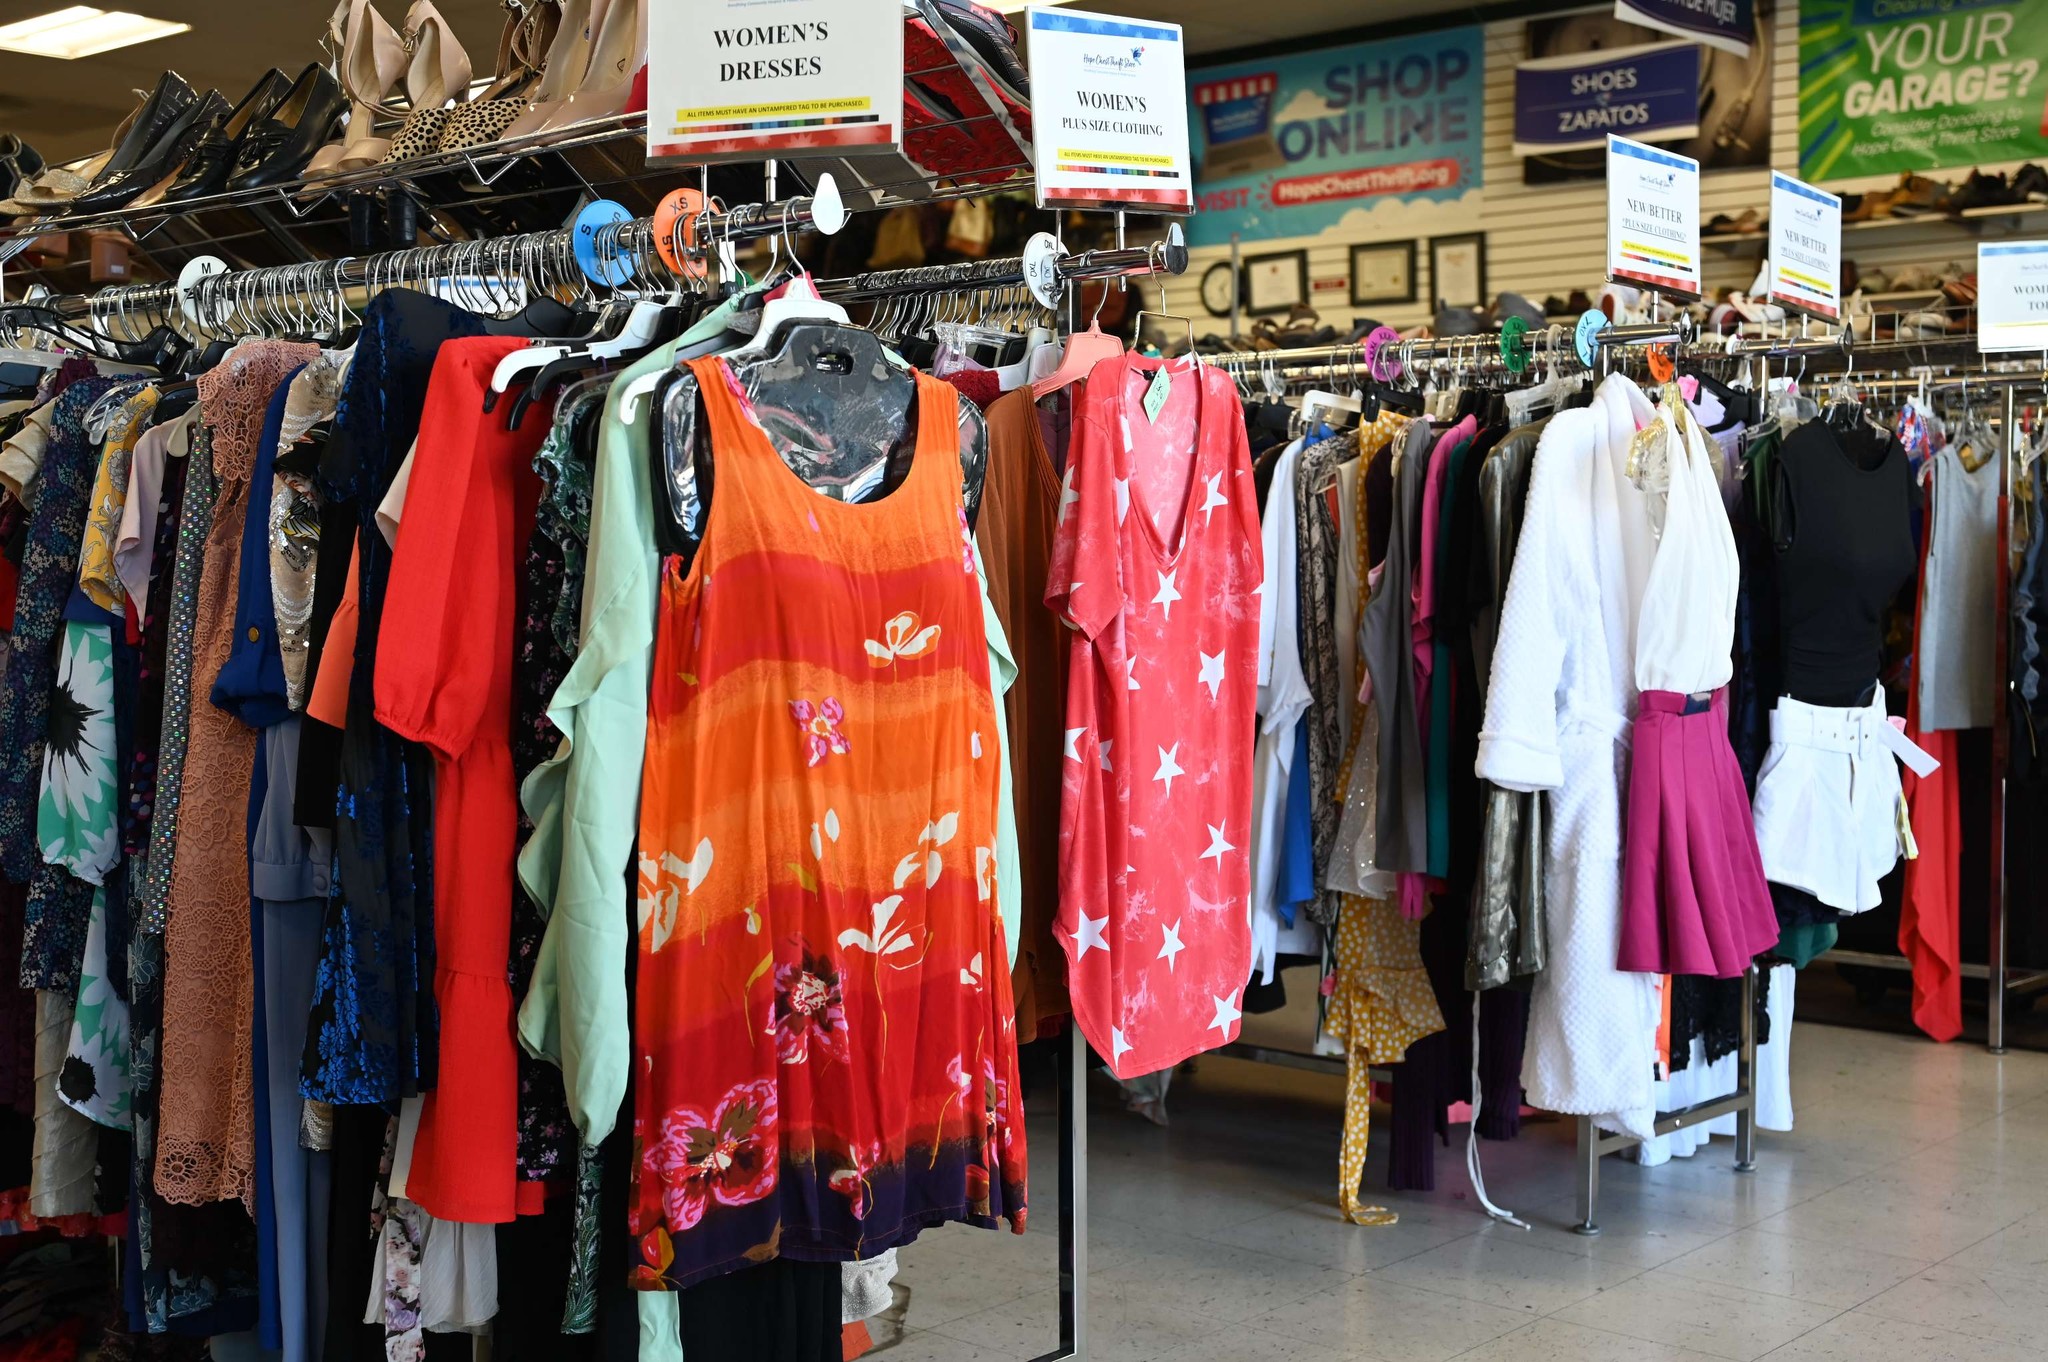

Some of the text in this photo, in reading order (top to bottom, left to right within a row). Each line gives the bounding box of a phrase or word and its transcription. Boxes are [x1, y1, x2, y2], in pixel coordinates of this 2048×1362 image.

[713, 21, 829, 49] WOMEN'S
[1866, 11, 2014, 75] YOUR
[719, 56, 822, 82] DRESSES
[1325, 48, 1471, 110] SHOP
[1571, 67, 1637, 96] SHOES
[1843, 58, 2039, 118] GARAGE?
[758, 104, 797, 113] UNTAMPERED
[1076, 90, 1147, 113] WOMEN'S
[1062, 117, 1163, 136] PLUS SIZE CLOTHING
[1278, 97, 1469, 162] ONLINE
[1558, 103, 1649, 133] ZAPATOS
[1980, 125, 2020, 143] Store
[1195, 166, 1450, 213] VISIT HopeChestThrift.org
[670, 197, 688, 215] XS
[581, 223, 592, 236] S
[201, 262, 212, 274] M
[2013, 285, 2048, 295] WOM
[2029, 301, 2048, 311] TO
